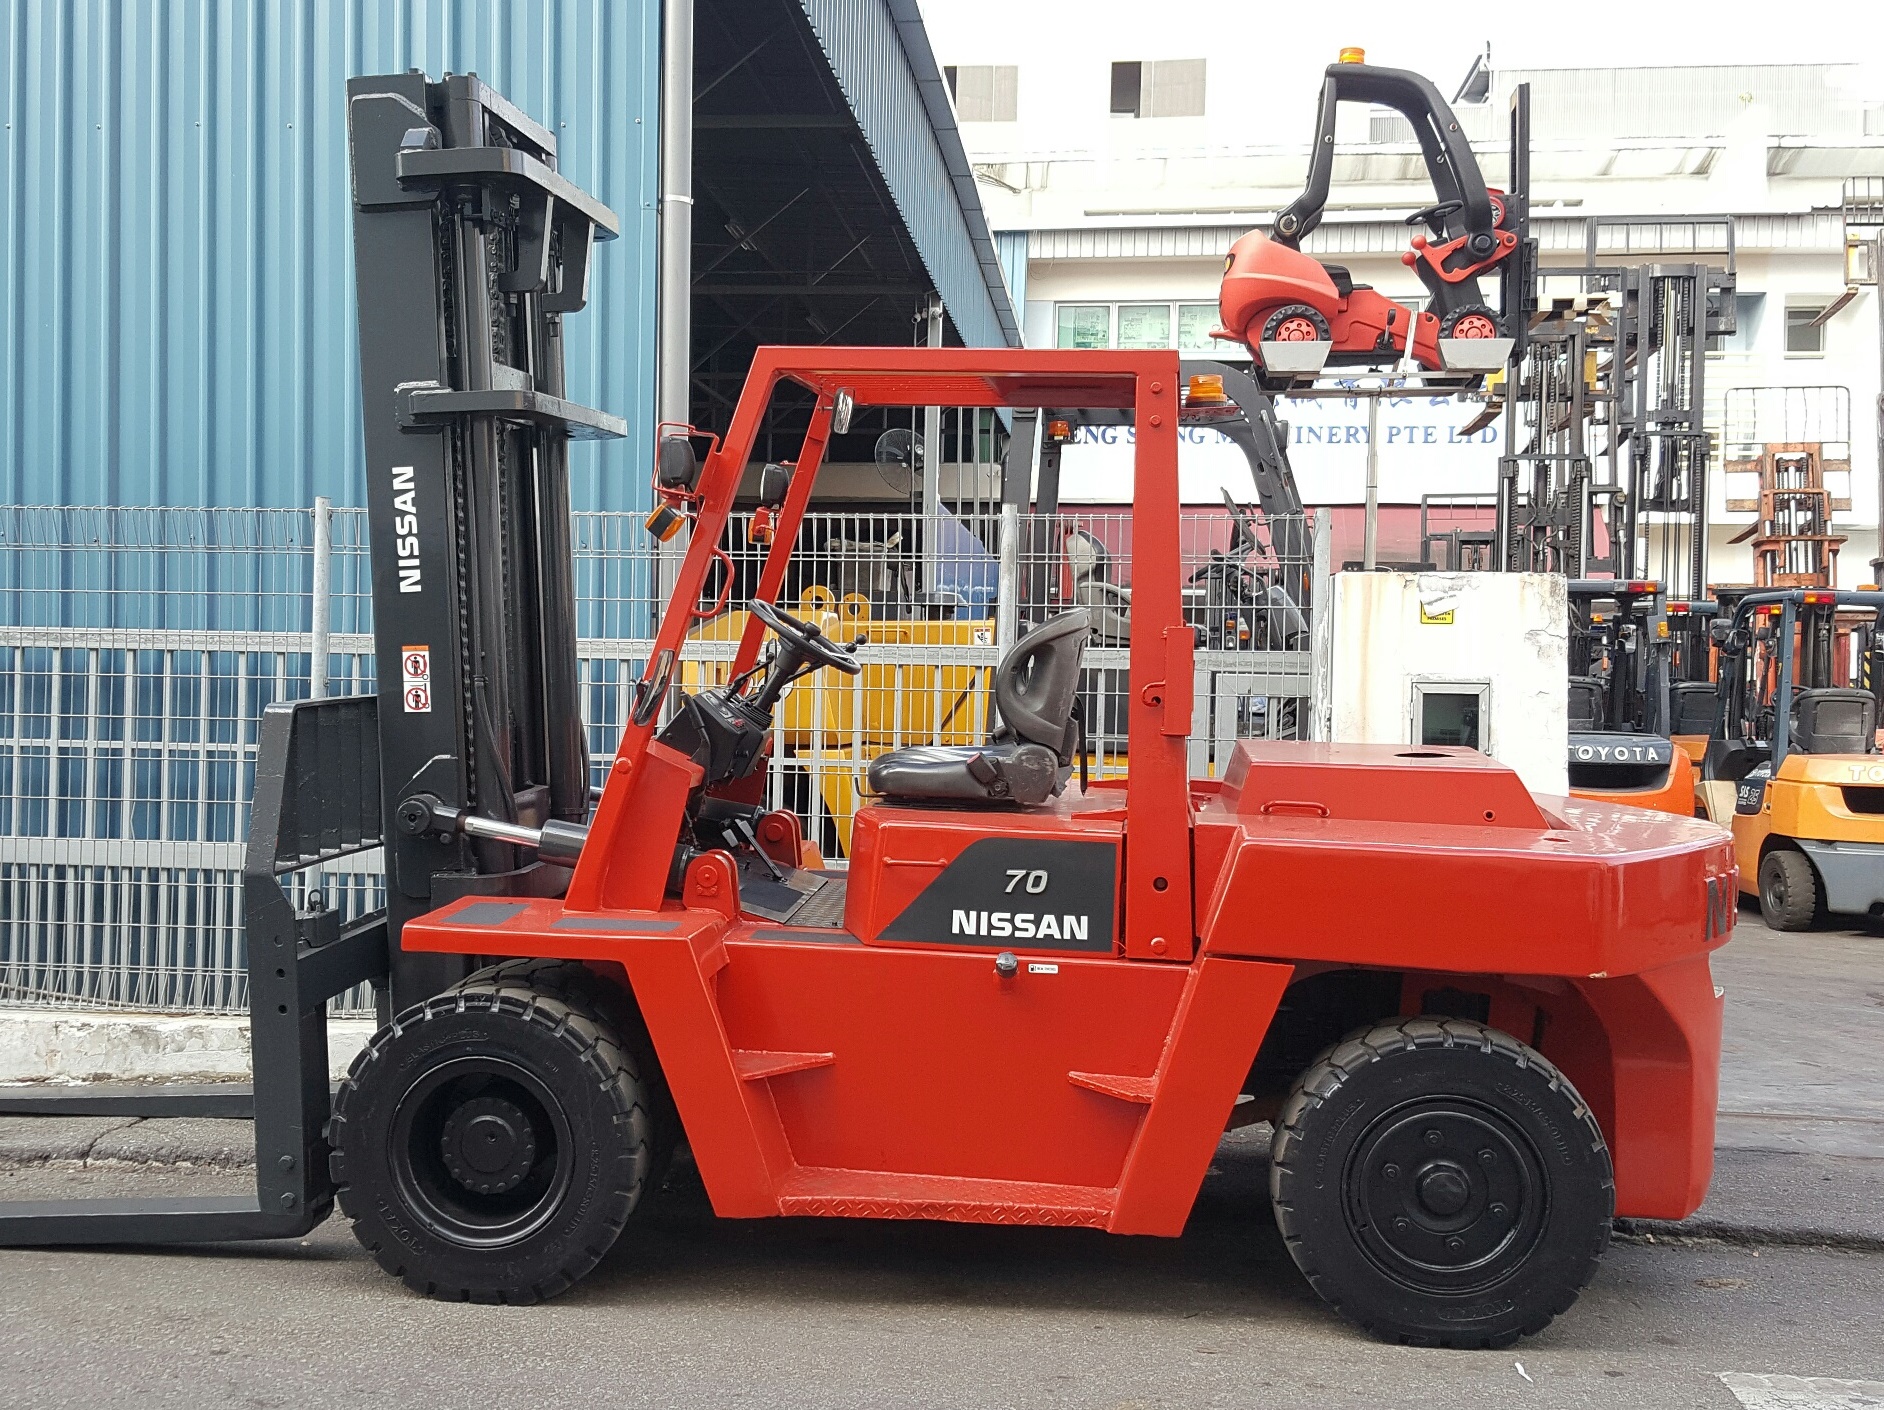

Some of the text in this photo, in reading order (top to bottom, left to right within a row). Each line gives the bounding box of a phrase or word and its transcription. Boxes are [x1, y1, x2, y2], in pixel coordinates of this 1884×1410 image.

[1386, 426, 1438, 444] PTE
[1447, 426, 1498, 444] LD
[391, 466, 422, 593] NISSAN
[1004, 869, 1048, 894] 70
[951, 909, 1089, 940] NISSAN
